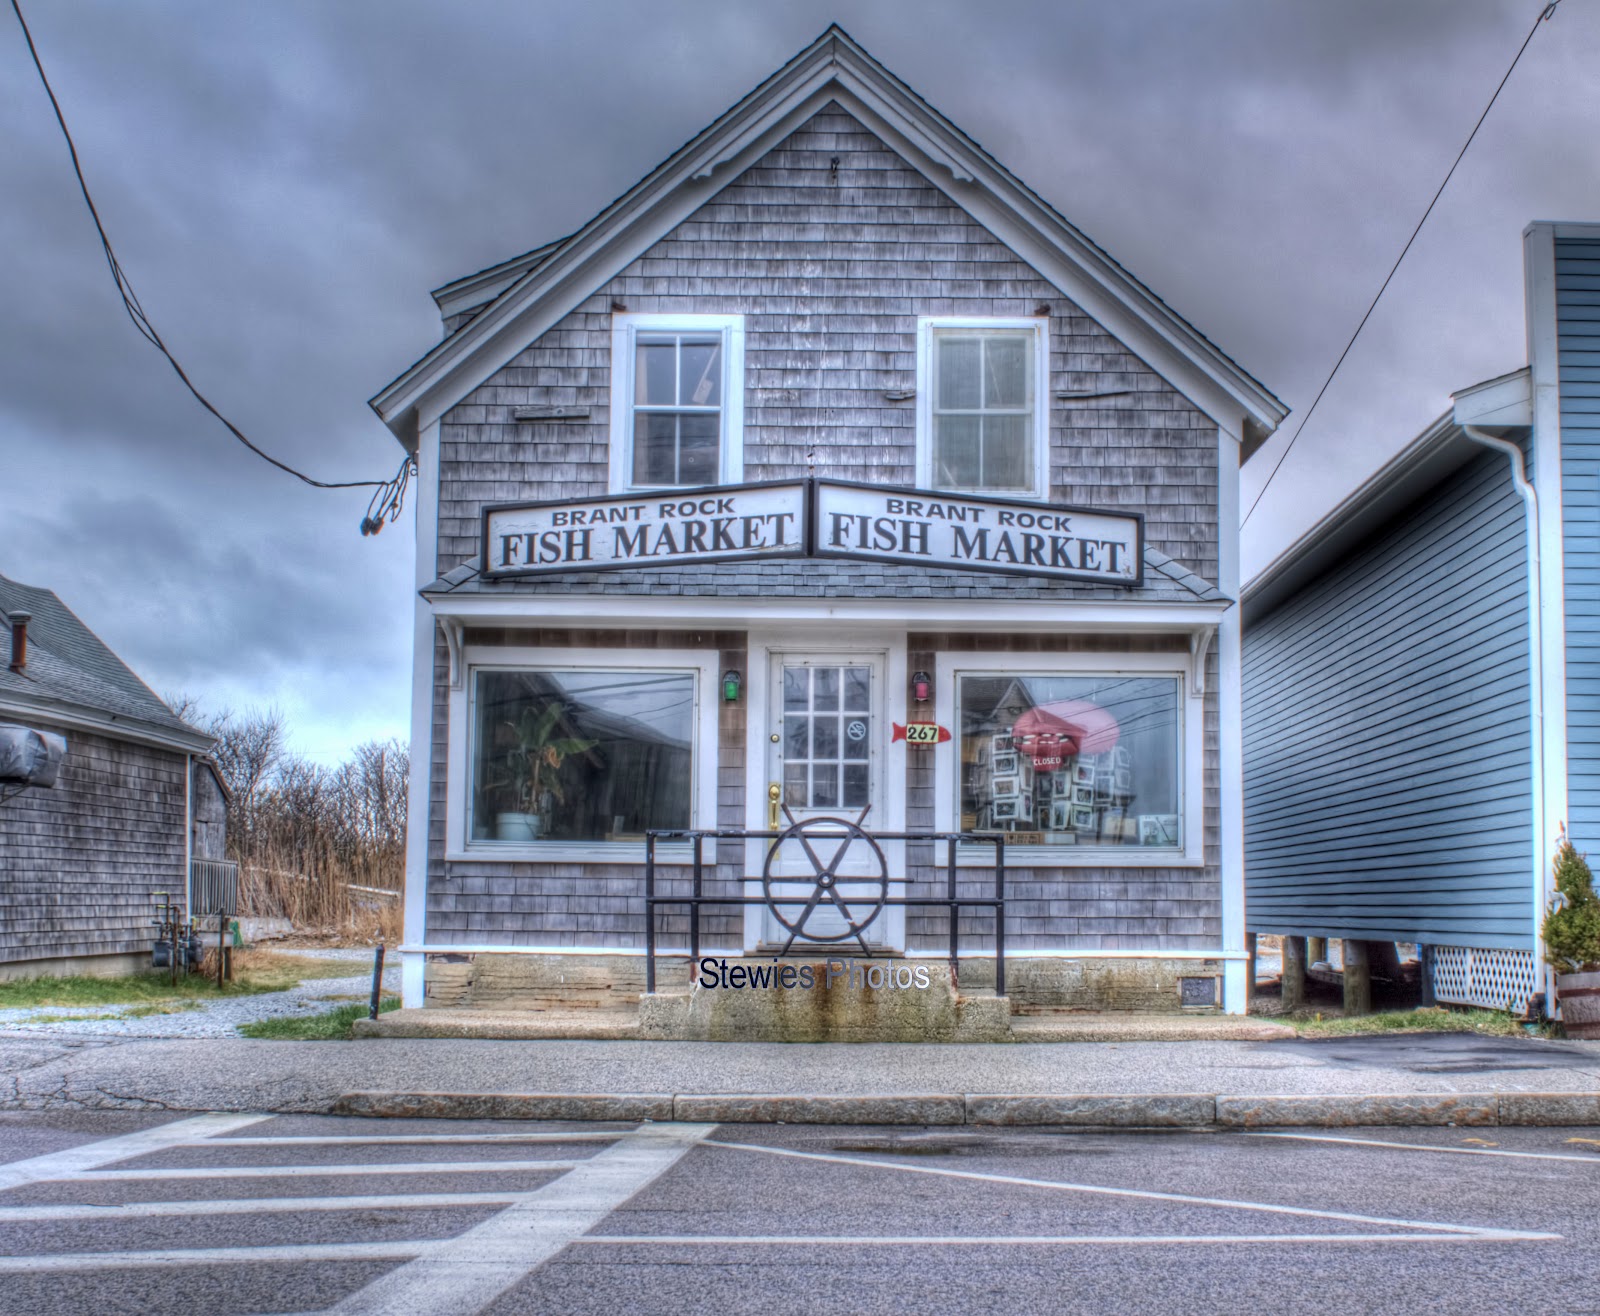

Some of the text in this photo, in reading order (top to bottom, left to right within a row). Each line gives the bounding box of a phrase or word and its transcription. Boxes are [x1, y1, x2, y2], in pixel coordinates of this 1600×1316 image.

[552, 497, 736, 527] BRANT ROCK
[886, 498, 1072, 532] BRANT ROCK
[499, 512, 794, 566] FISH MARKET
[828, 512, 1126, 573] FISH MARKET
[907, 726, 938, 741] 267
[1033, 757, 1061, 766] CLOSED
